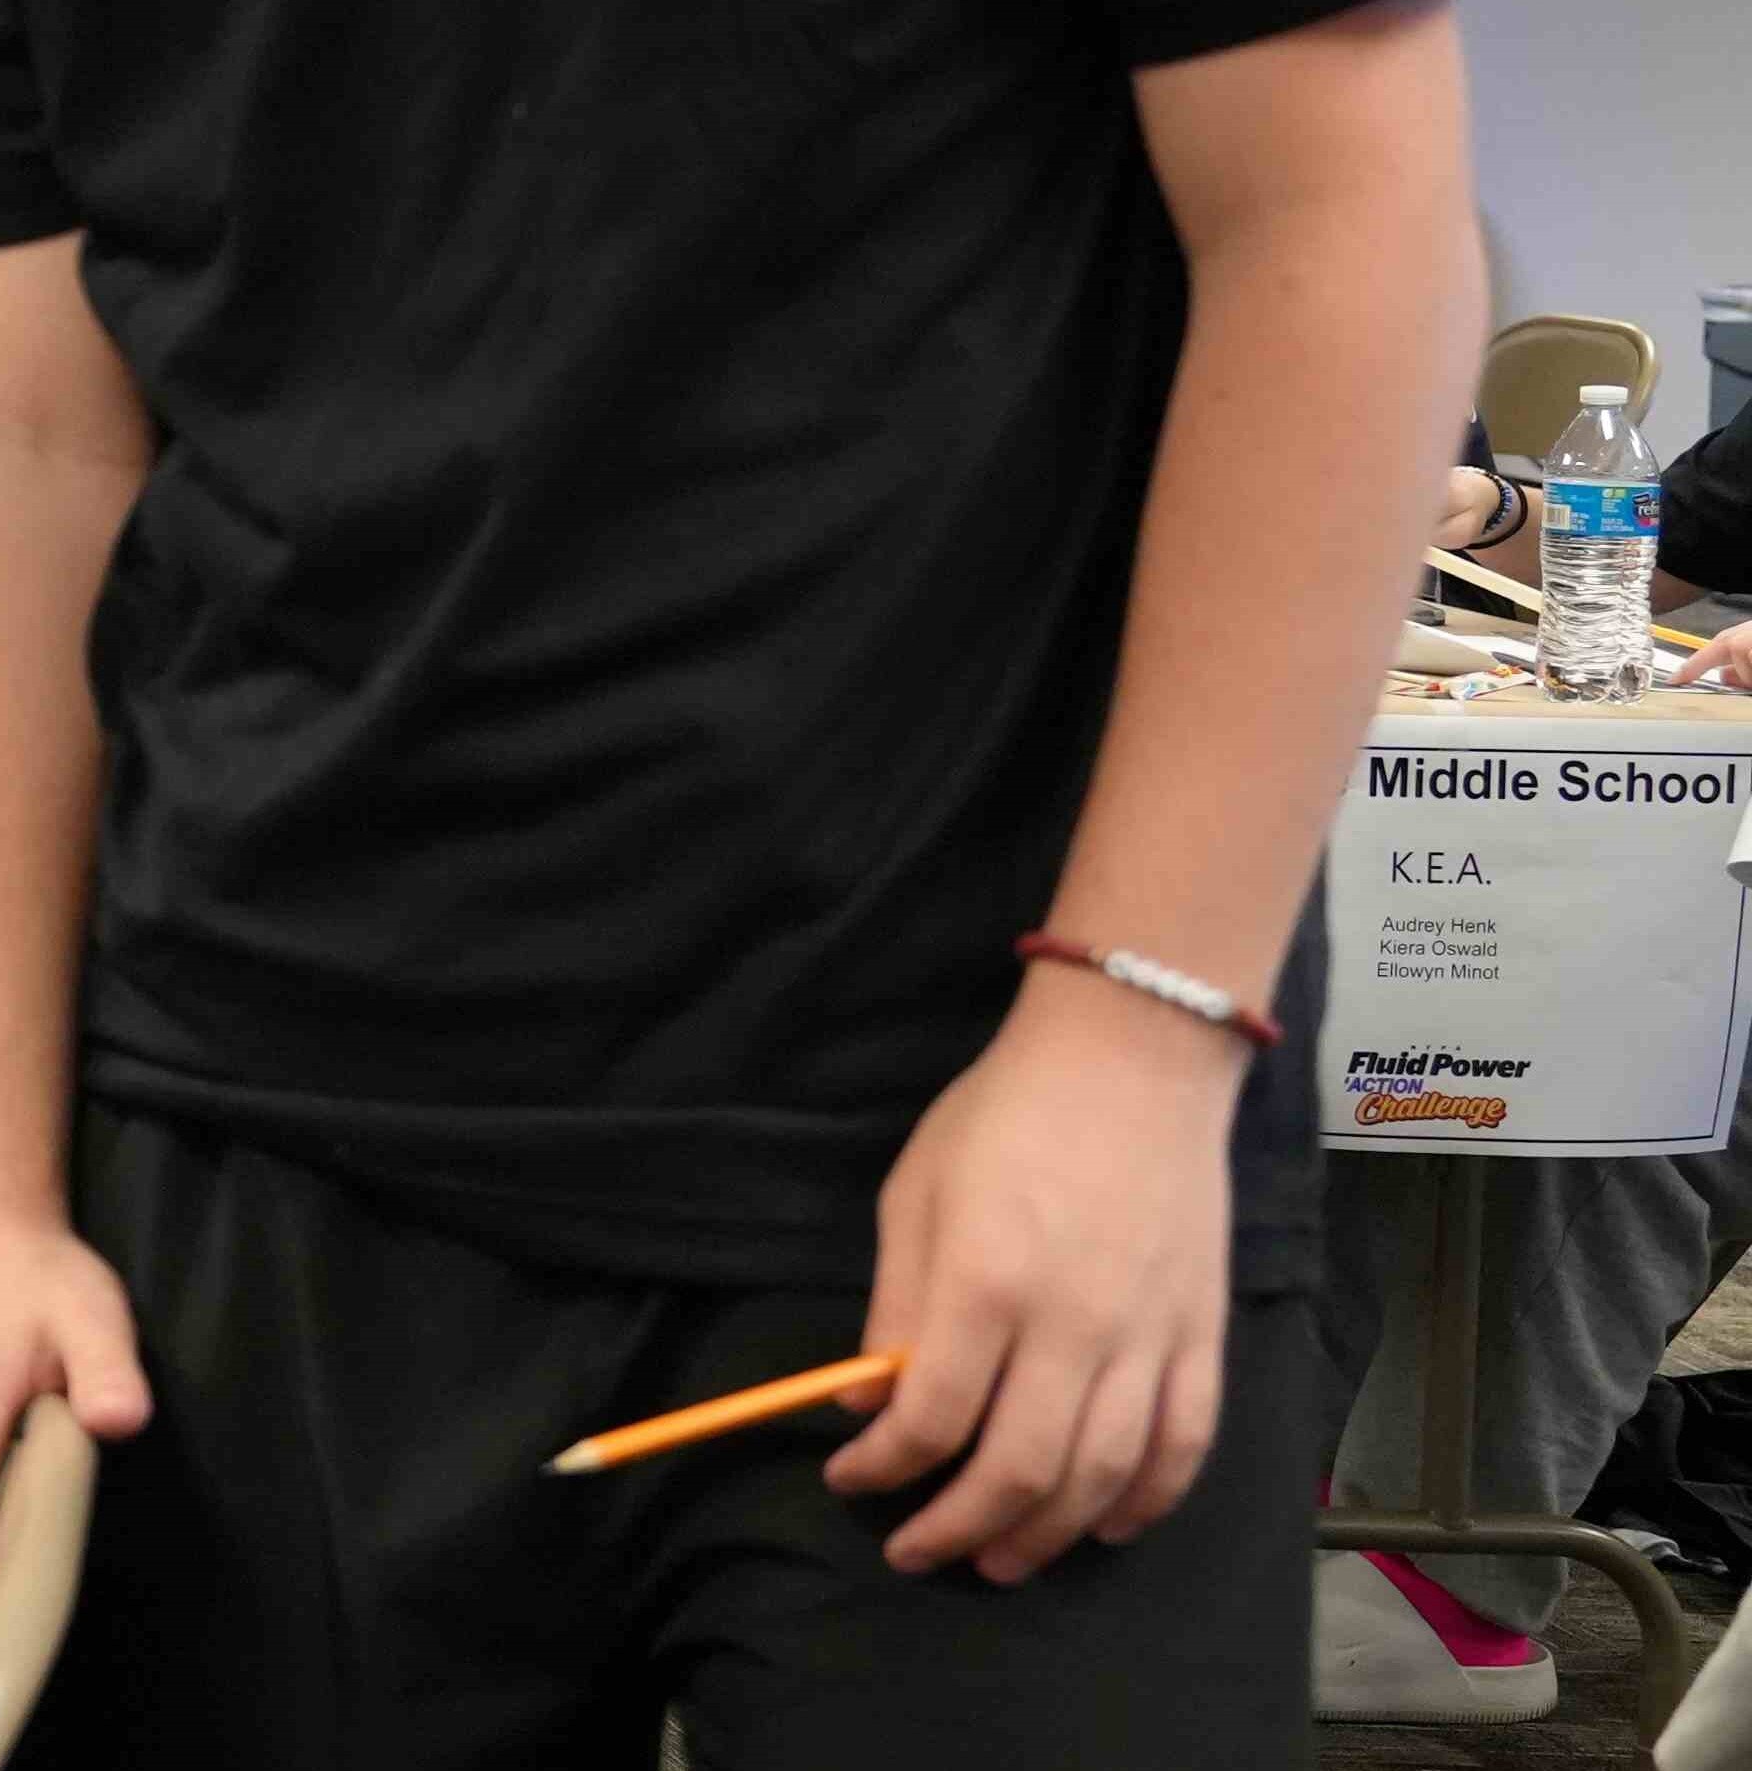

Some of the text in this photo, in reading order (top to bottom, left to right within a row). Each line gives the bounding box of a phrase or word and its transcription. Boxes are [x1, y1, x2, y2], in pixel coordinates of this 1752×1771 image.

[1369, 756, 1736, 804] Middle School
[1392, 851, 1492, 885] K.E.A.
[1382, 916, 1496, 936] Audrey Henk
[1380, 940, 1497, 957] Kiera Oswald
[1377, 962, 1499, 982] Ellowyn Minot
[1348, 1051, 1531, 1078] Fluid Power
[1346, 1078, 1424, 1094] ACTION
[1354, 1091, 1506, 1128] Challenge
